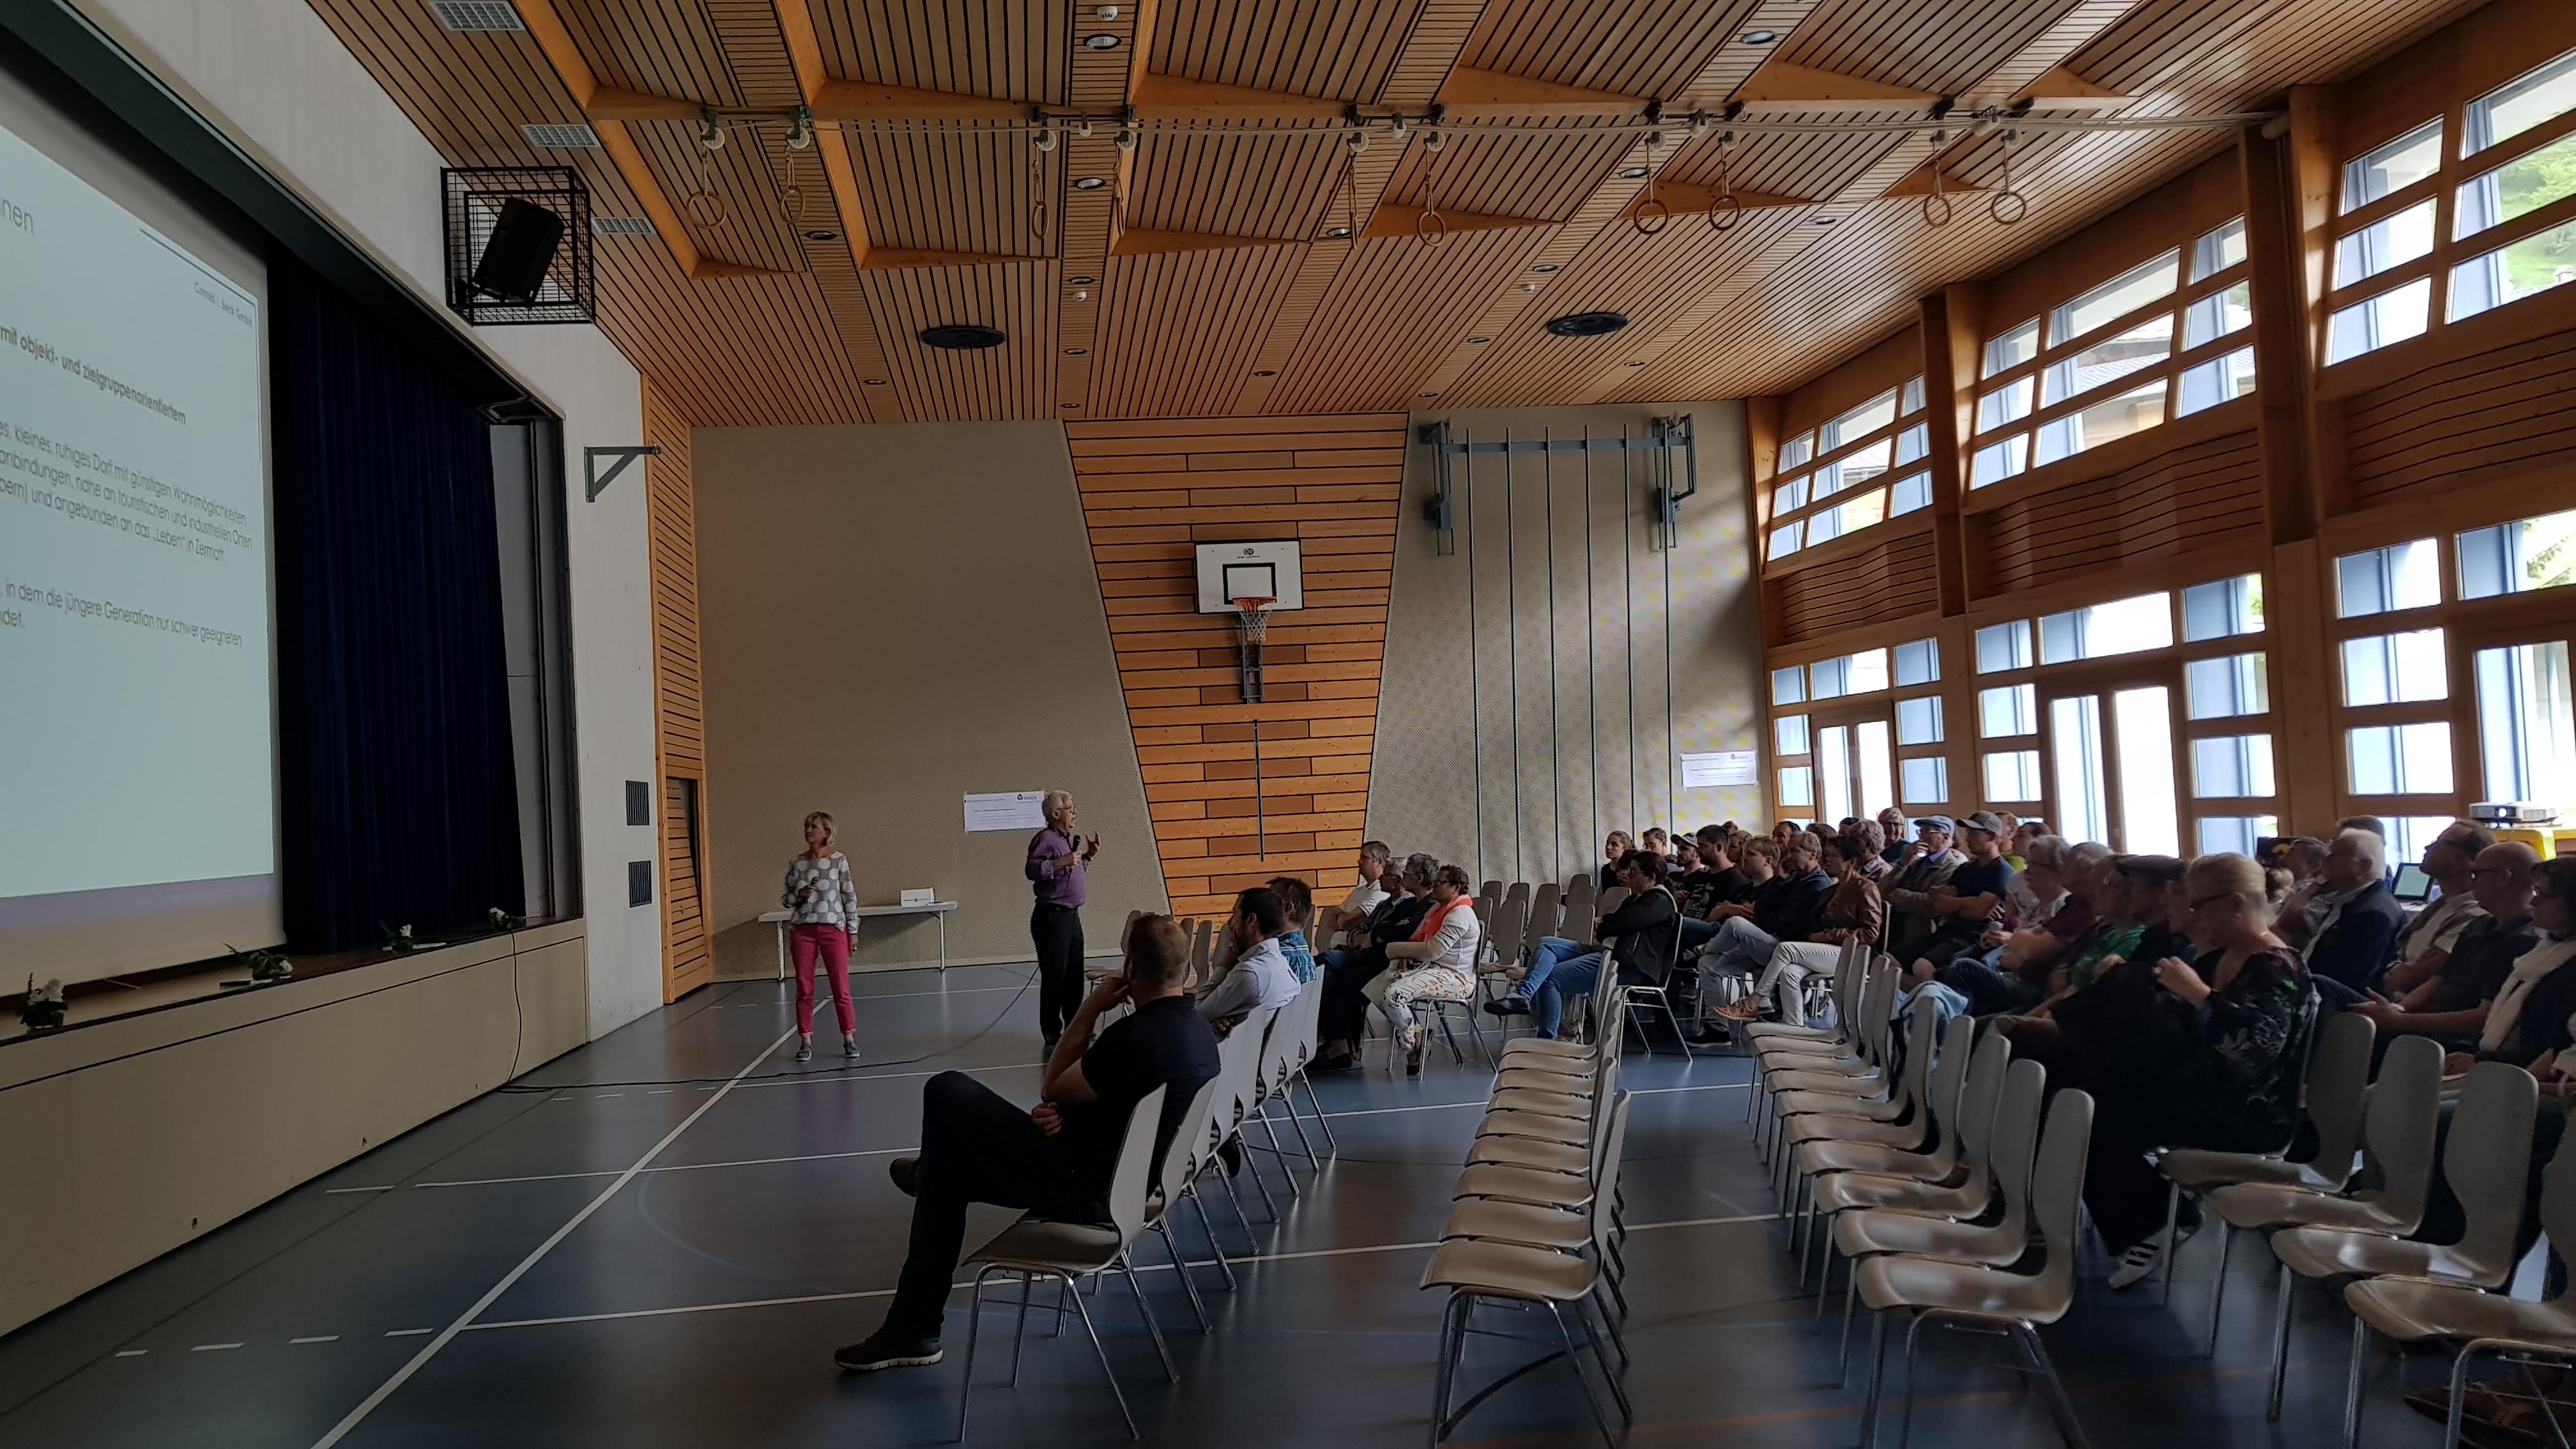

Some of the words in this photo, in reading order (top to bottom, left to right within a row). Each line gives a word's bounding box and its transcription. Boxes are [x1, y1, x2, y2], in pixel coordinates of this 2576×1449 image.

[0, 326, 17, 346] mit
[20, 334, 58, 363] objekt-
[61, 355, 80, 375] und
[83, 364, 187, 425] zielgruppenorientiertem
[31, 489, 52, 507] und
[55, 496, 119, 528] angebunden
[120, 517, 133, 532] an
[134, 521, 151, 539] das
[55, 442, 91, 468] ruhiges
[93, 452, 112, 475] Dorf
[114, 464, 129, 482] mit
[131, 470, 172, 499] günstigen
[173, 486, 247, 526] Wohnmöglichkeiten
[76, 476, 102, 497] nahe
[103, 486, 116, 505] an
[118, 487, 170, 521] touristischen
[171, 510, 187, 527] und
[188, 514, 232, 542] industriellen
[233, 529, 253, 550] Orten
[5, 578, 16, 599] in
[19, 584, 44, 604] dem
[46, 588, 63, 608] die
[65, 592, 103, 618] jüngere
[104, 601, 155, 629] Generation
[156, 616, 169, 631] nur
[171, 618, 199, 638] schwer
[200, 625, 243, 647] geeigneten
